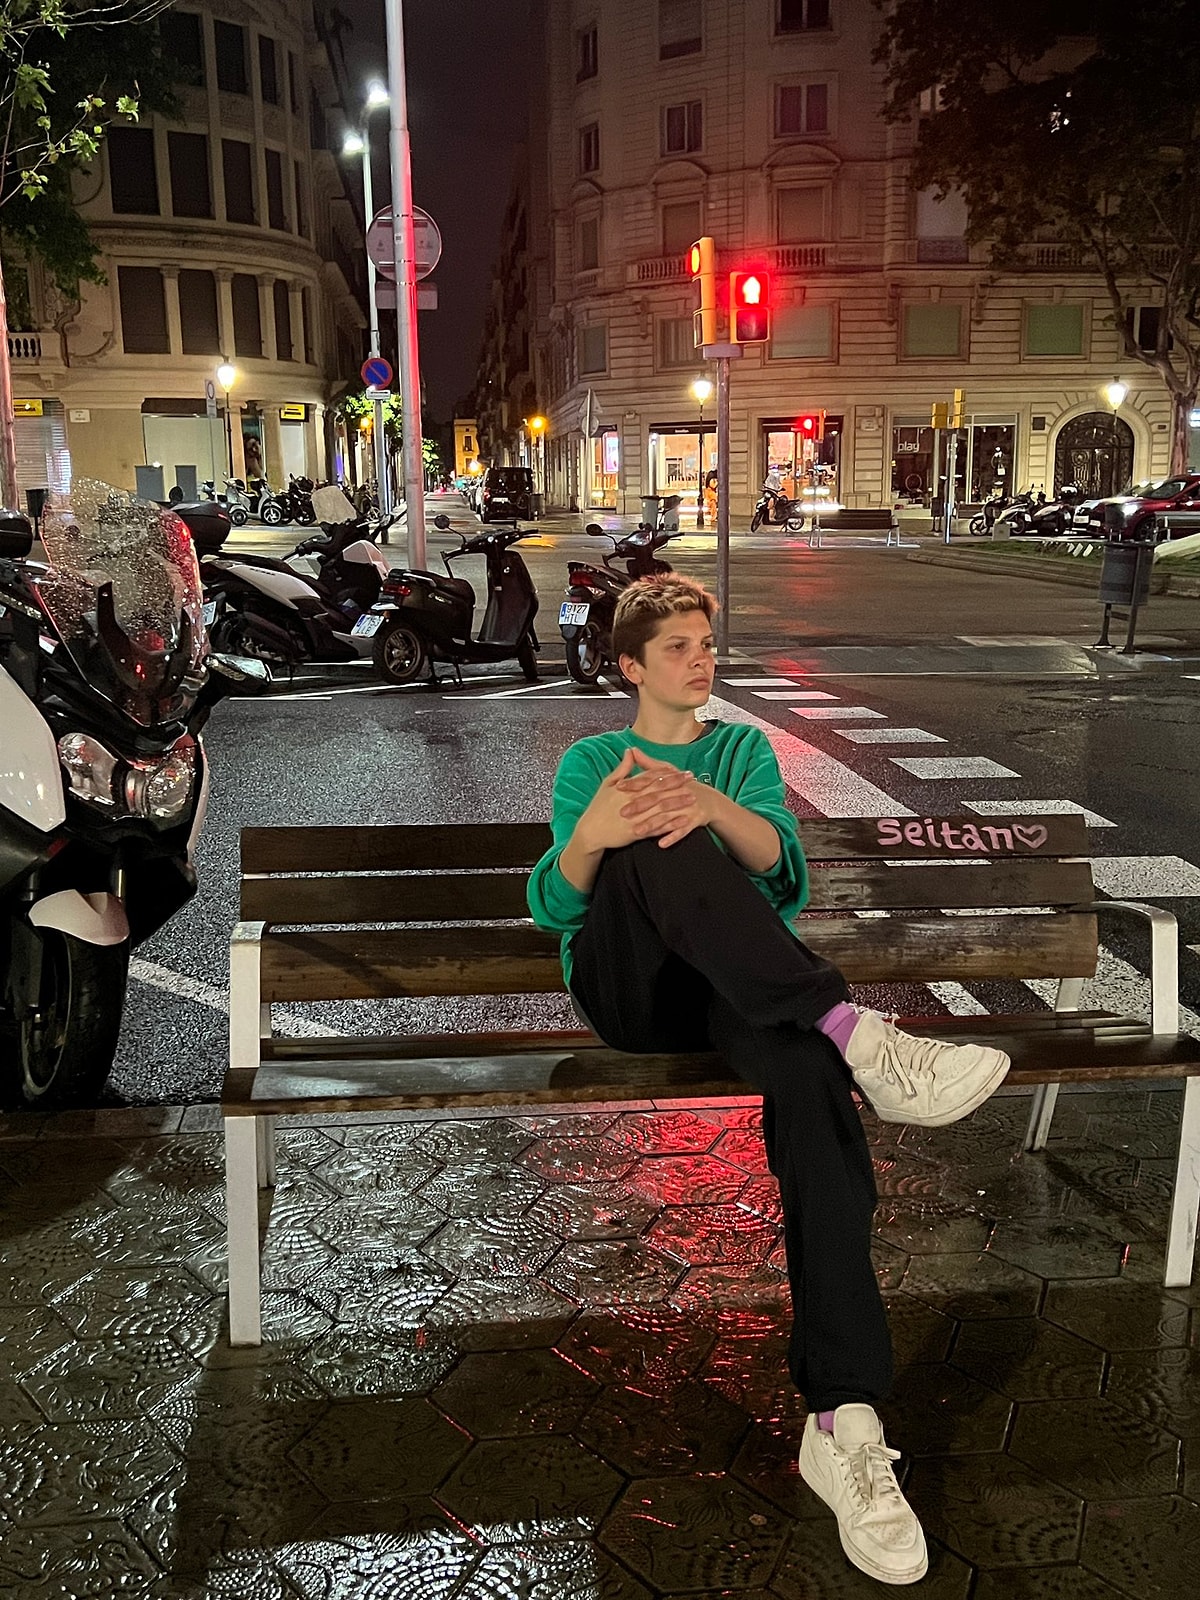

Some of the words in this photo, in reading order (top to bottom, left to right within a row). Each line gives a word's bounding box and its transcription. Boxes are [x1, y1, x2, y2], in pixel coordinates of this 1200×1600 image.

[897, 441, 919, 452] play
[567, 604, 588, 613] 9127
[877, 818, 1015, 852] Seitan
